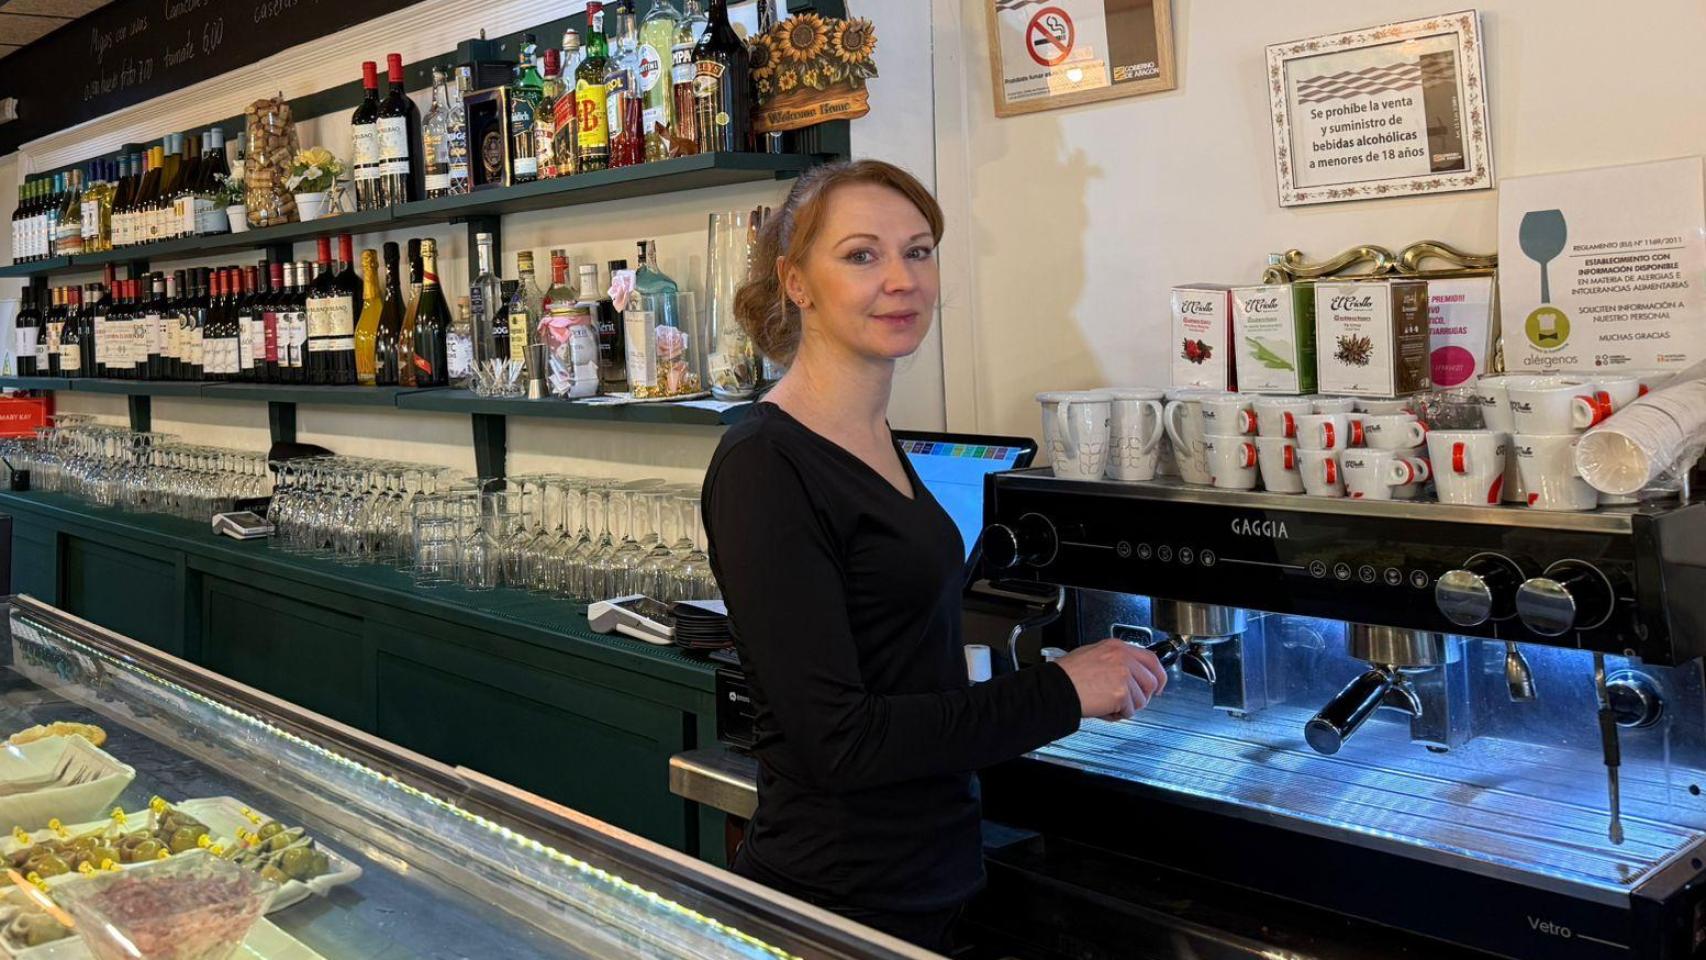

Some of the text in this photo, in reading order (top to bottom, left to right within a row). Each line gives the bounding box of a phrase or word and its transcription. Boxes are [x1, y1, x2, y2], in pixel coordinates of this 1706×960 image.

[767, 102, 850, 124] Welcome Home
[1310, 109, 1323, 119] Se
[1369, 100, 1380, 111] la
[1382, 97, 1413, 109] venta
[1321, 114, 1403, 136] y suministro de
[1313, 131, 1417, 152] bebidas alcohólicas
[1309, 147, 1425, 169] a menores de 18 años
[1573, 241, 1618, 251] REGLAMENTO
[1585, 253, 1670, 266] ESTABLECIMIENTO CON
[1578, 262, 1679, 276] INFORMACIÓN DISPONIBLE
[1590, 276, 1623, 285] MATERIA
[1624, 274, 1635, 282] DE
[1637, 272, 1674, 281] ALERGIAS
[1571, 281, 1689, 295] INTOLERANCIAS ALIMENTARIAS
[1578, 305, 1616, 314] SOLICITEN
[1617, 301, 1676, 312] INFORMACIÓN
[1593, 312, 1670, 323] NUESTRO PERSONAL
[1598, 331, 1671, 342] MUCHAS GRACIAS
[1523, 354, 1579, 368] alérgenos
[1231, 517, 1289, 539] GAGGIA
[1527, 915, 1571, 938] Vetro
